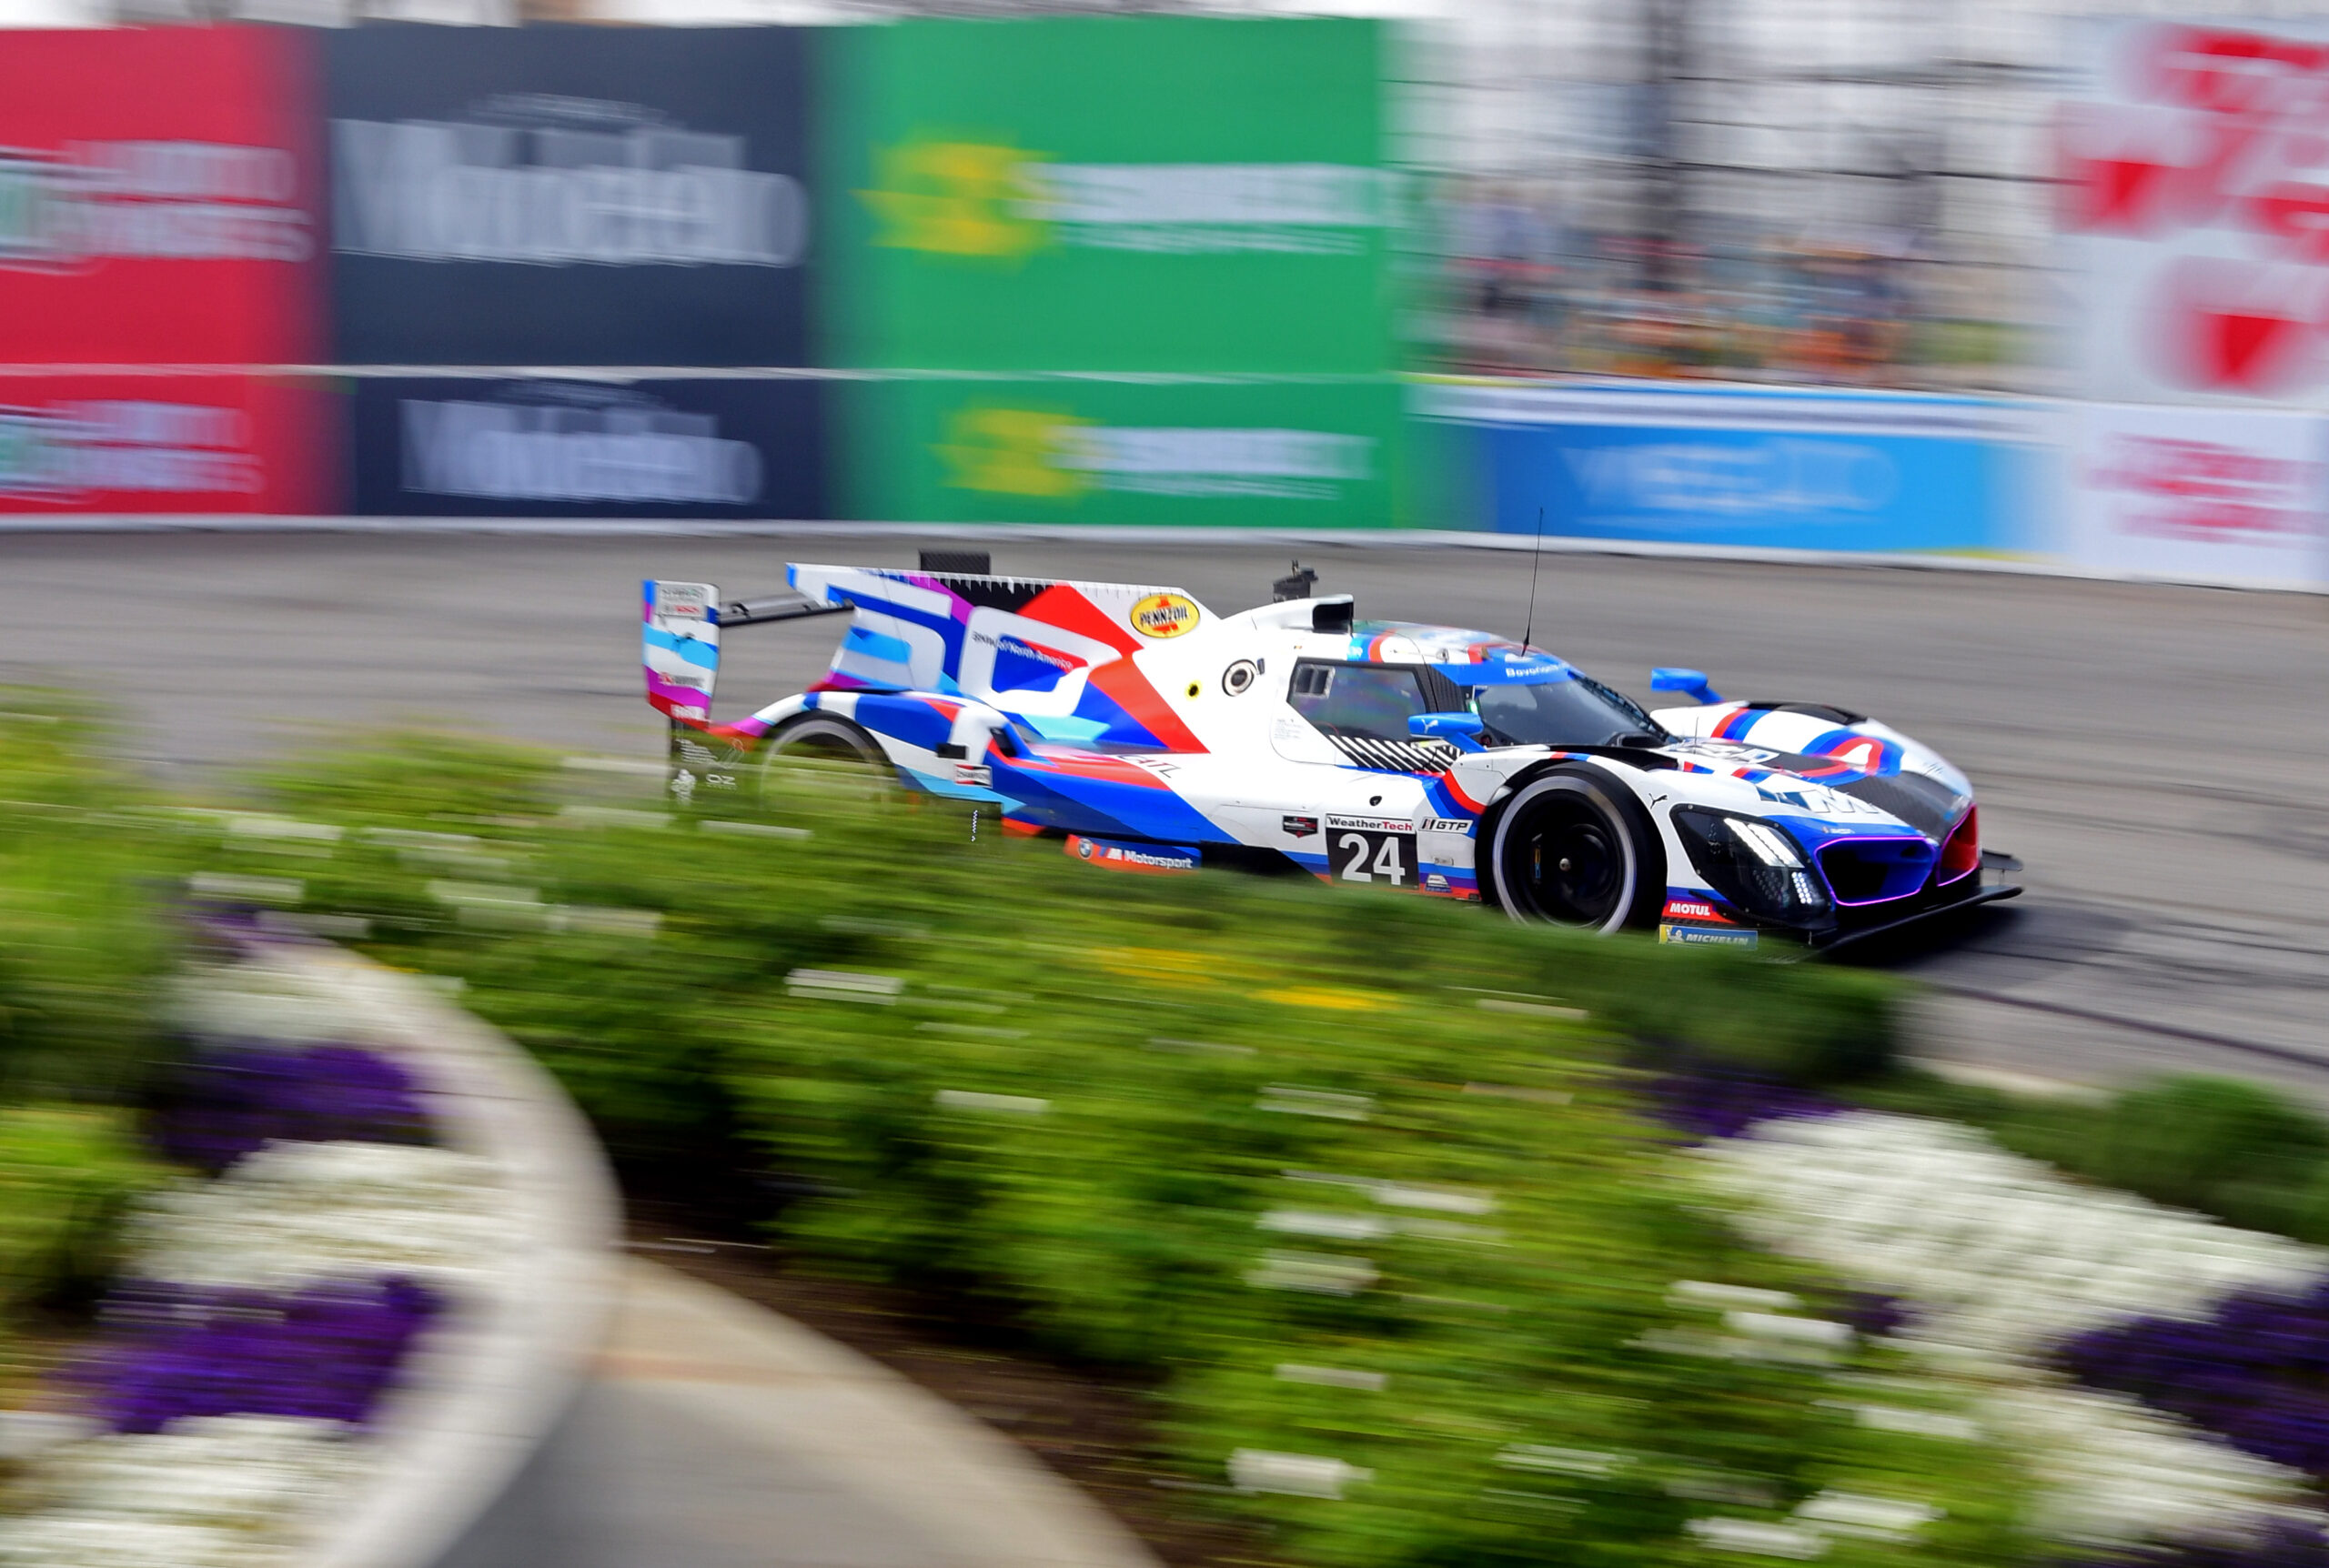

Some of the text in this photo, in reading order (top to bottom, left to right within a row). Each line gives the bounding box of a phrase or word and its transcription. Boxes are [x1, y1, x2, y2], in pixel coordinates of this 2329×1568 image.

[1140, 604, 1189, 628] PENNZOIL
[1328, 817, 1412, 831] WeatherTech
[1436, 820, 1468, 831] GTP
[1124, 849, 1193, 869] Motorsport
[1338, 832, 1406, 886] 24
[1669, 902, 1710, 916] MOTUL
[1686, 933, 1749, 946] MICHELIN
